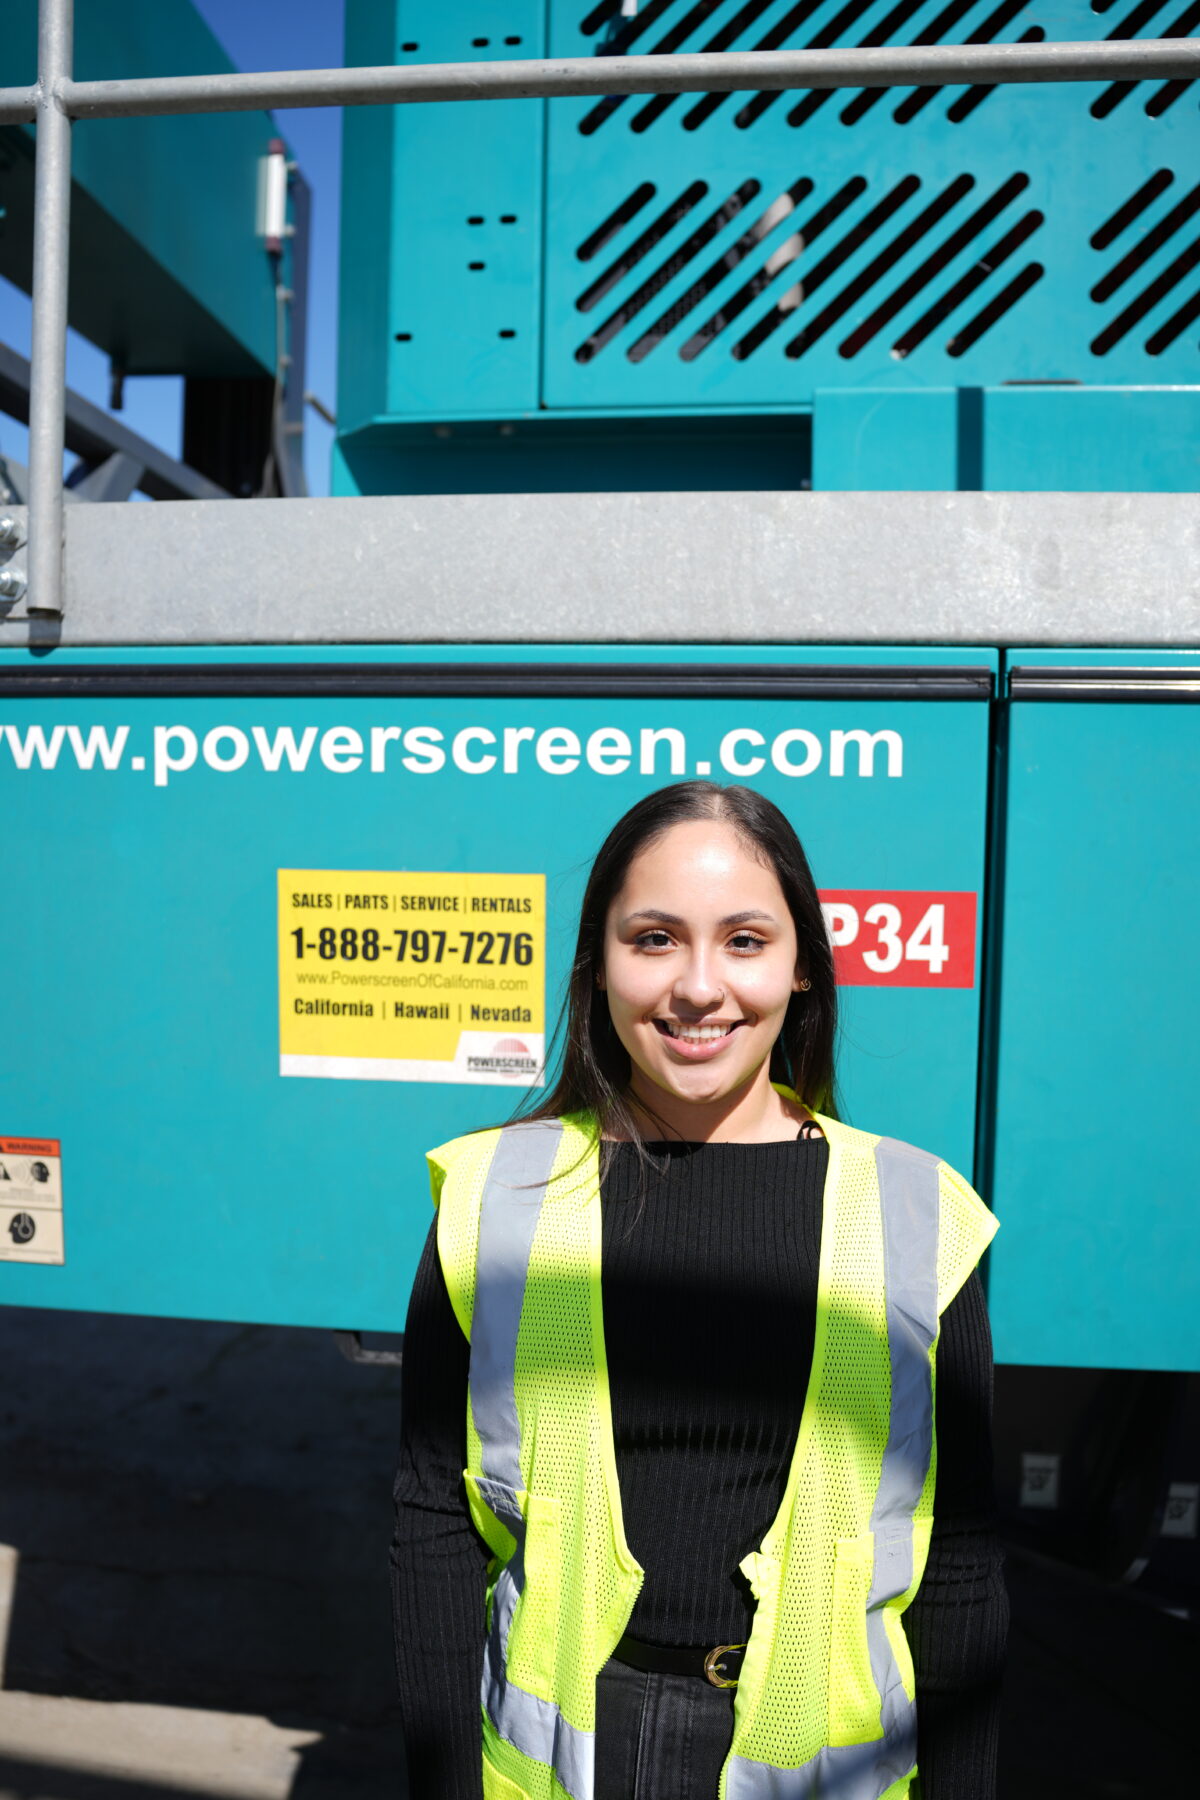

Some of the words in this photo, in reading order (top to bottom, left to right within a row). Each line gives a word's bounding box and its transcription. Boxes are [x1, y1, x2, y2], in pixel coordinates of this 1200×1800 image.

[0, 725, 903, 787] ww.powerscreen.com
[292, 893, 333, 909] SALES
[344, 894, 389, 910] PARTS
[400, 895, 460, 912] SERVICE
[471, 897, 532, 913] RENTALS
[291, 927, 534, 967] 1-888-797-7276
[820, 902, 950, 974] P34
[296, 970, 529, 992] www.PowerscreenOfCalifornia.com
[294, 998, 374, 1018] California
[394, 1001, 450, 1020] Hawaii
[470, 1004, 532, 1023] Nevada
[467, 1056, 537, 1068] POWERSCREEN
